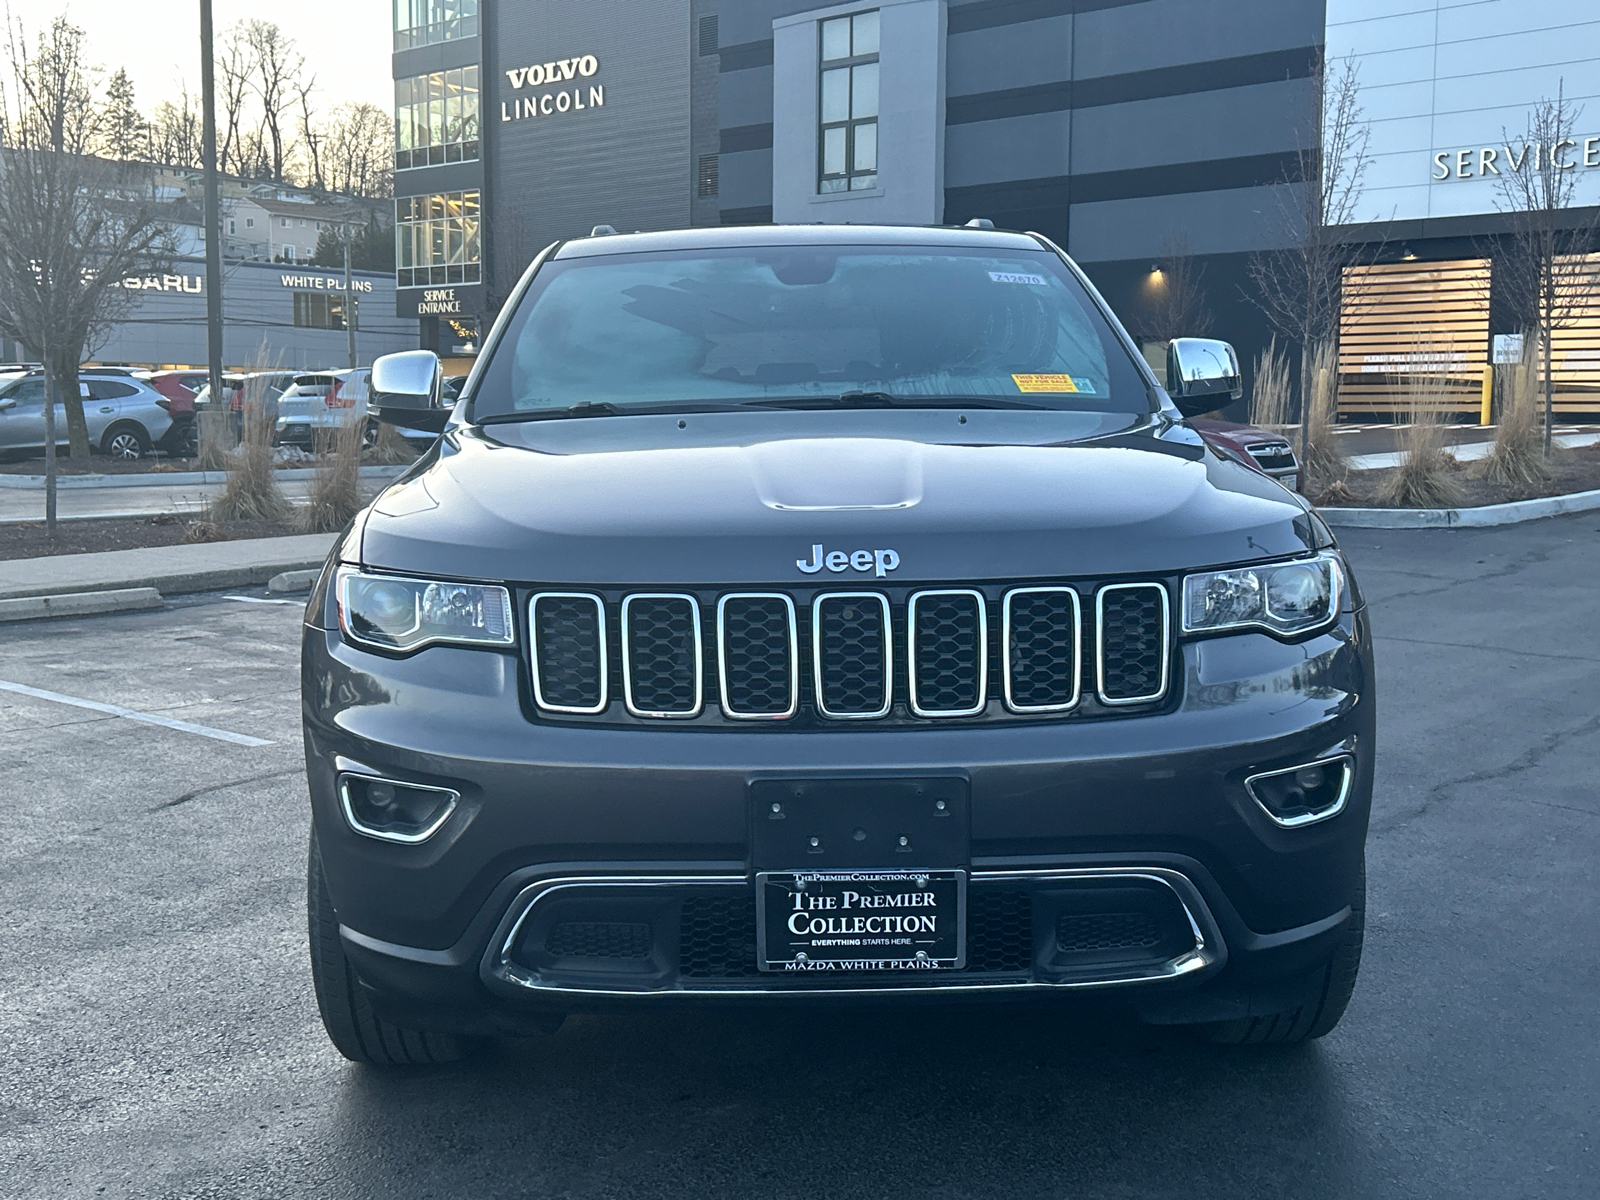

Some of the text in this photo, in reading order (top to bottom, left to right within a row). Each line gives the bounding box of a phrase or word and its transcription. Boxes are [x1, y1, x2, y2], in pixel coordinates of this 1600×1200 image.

[505, 55, 598, 89] VOLVO
[501, 85, 604, 122] LINCOLN
[1432, 136, 1600, 180] SERVICE
[281, 275, 324, 289] WHITE
[423, 289, 455, 302] SERVICE
[418, 301, 461, 314] ENTRANCE
[796, 544, 900, 578] Jeep
[811, 938, 861, 947] EVERYTHING
[862, 938, 890, 946] STARTS
[784, 960, 939, 971] MAZDA WHITE PLAINS
